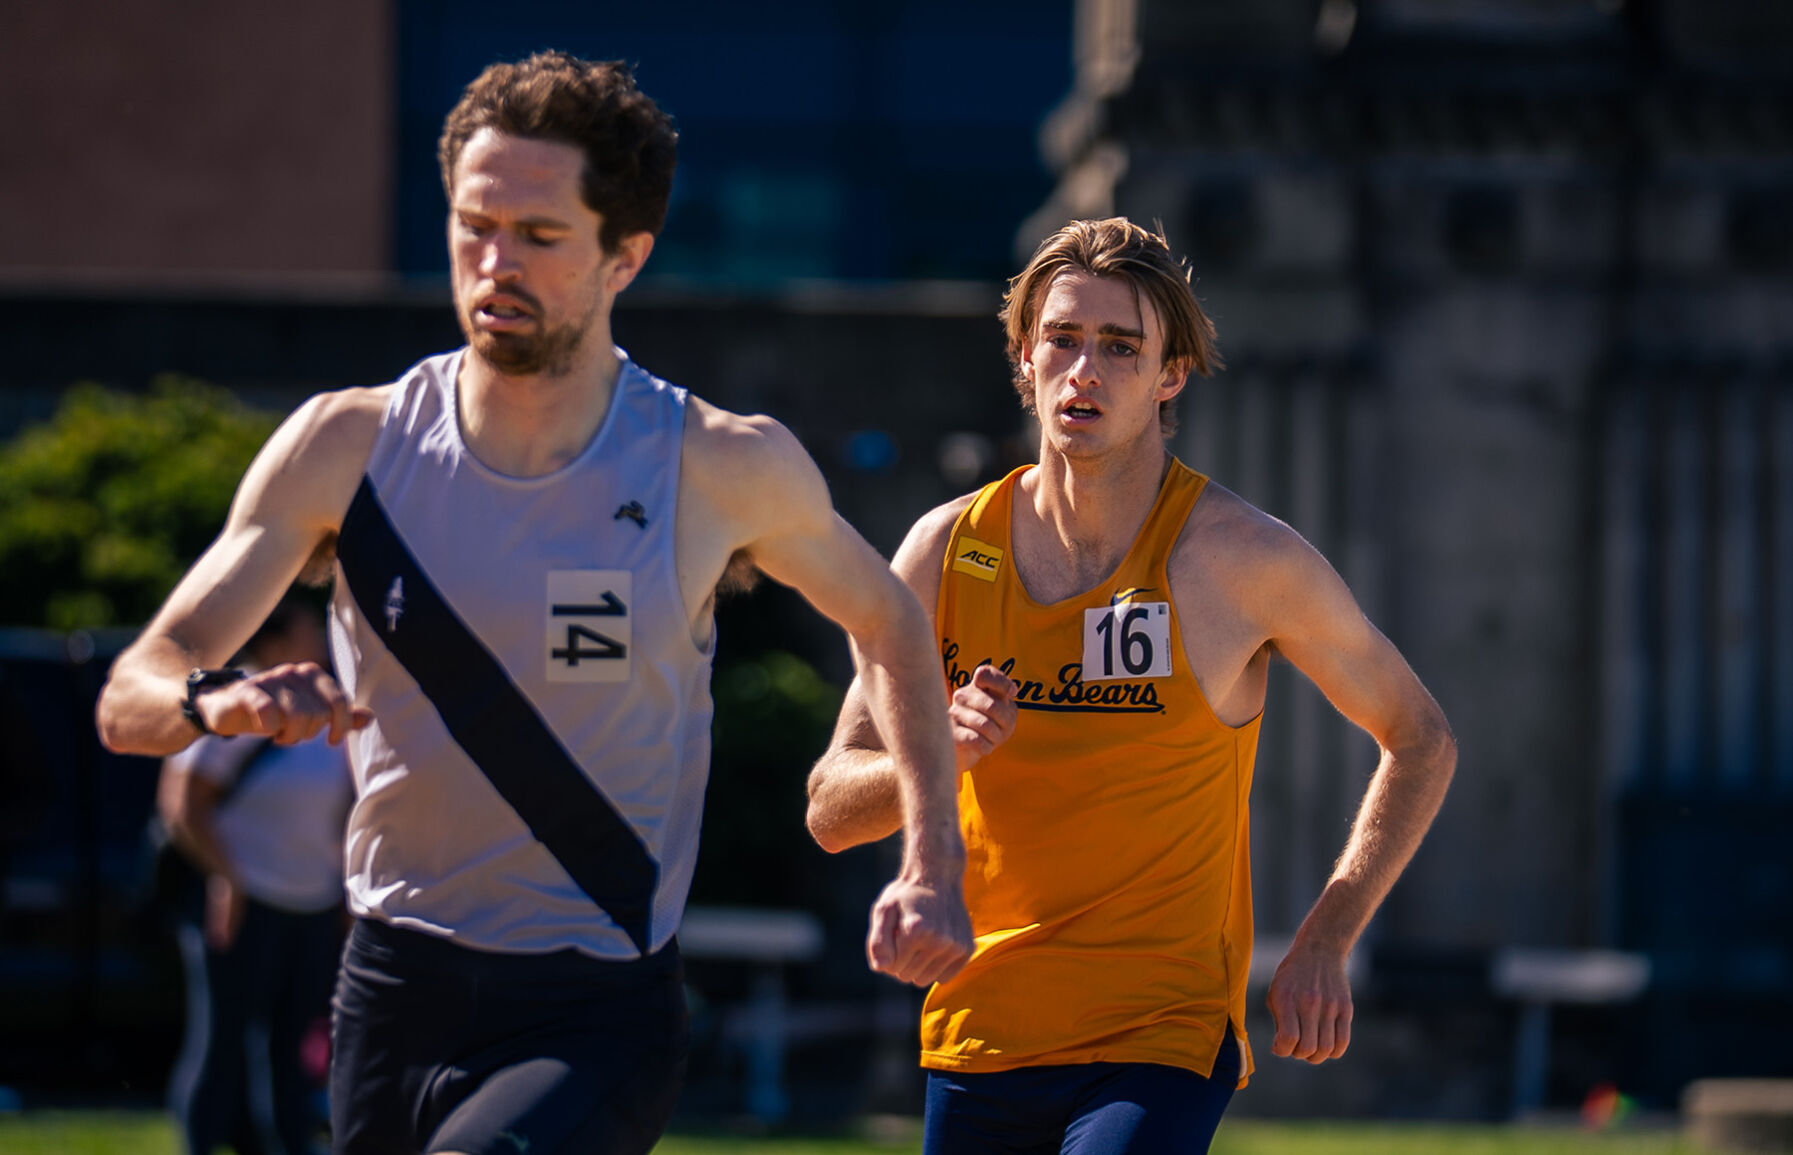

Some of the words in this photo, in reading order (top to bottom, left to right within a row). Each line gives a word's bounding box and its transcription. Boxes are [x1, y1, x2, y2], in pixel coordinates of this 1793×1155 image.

[960, 550, 1000, 569] ACC
[552, 590, 627, 667] 14
[1096, 607, 1153, 676] 16
[1049, 663, 1158, 705] Bears
